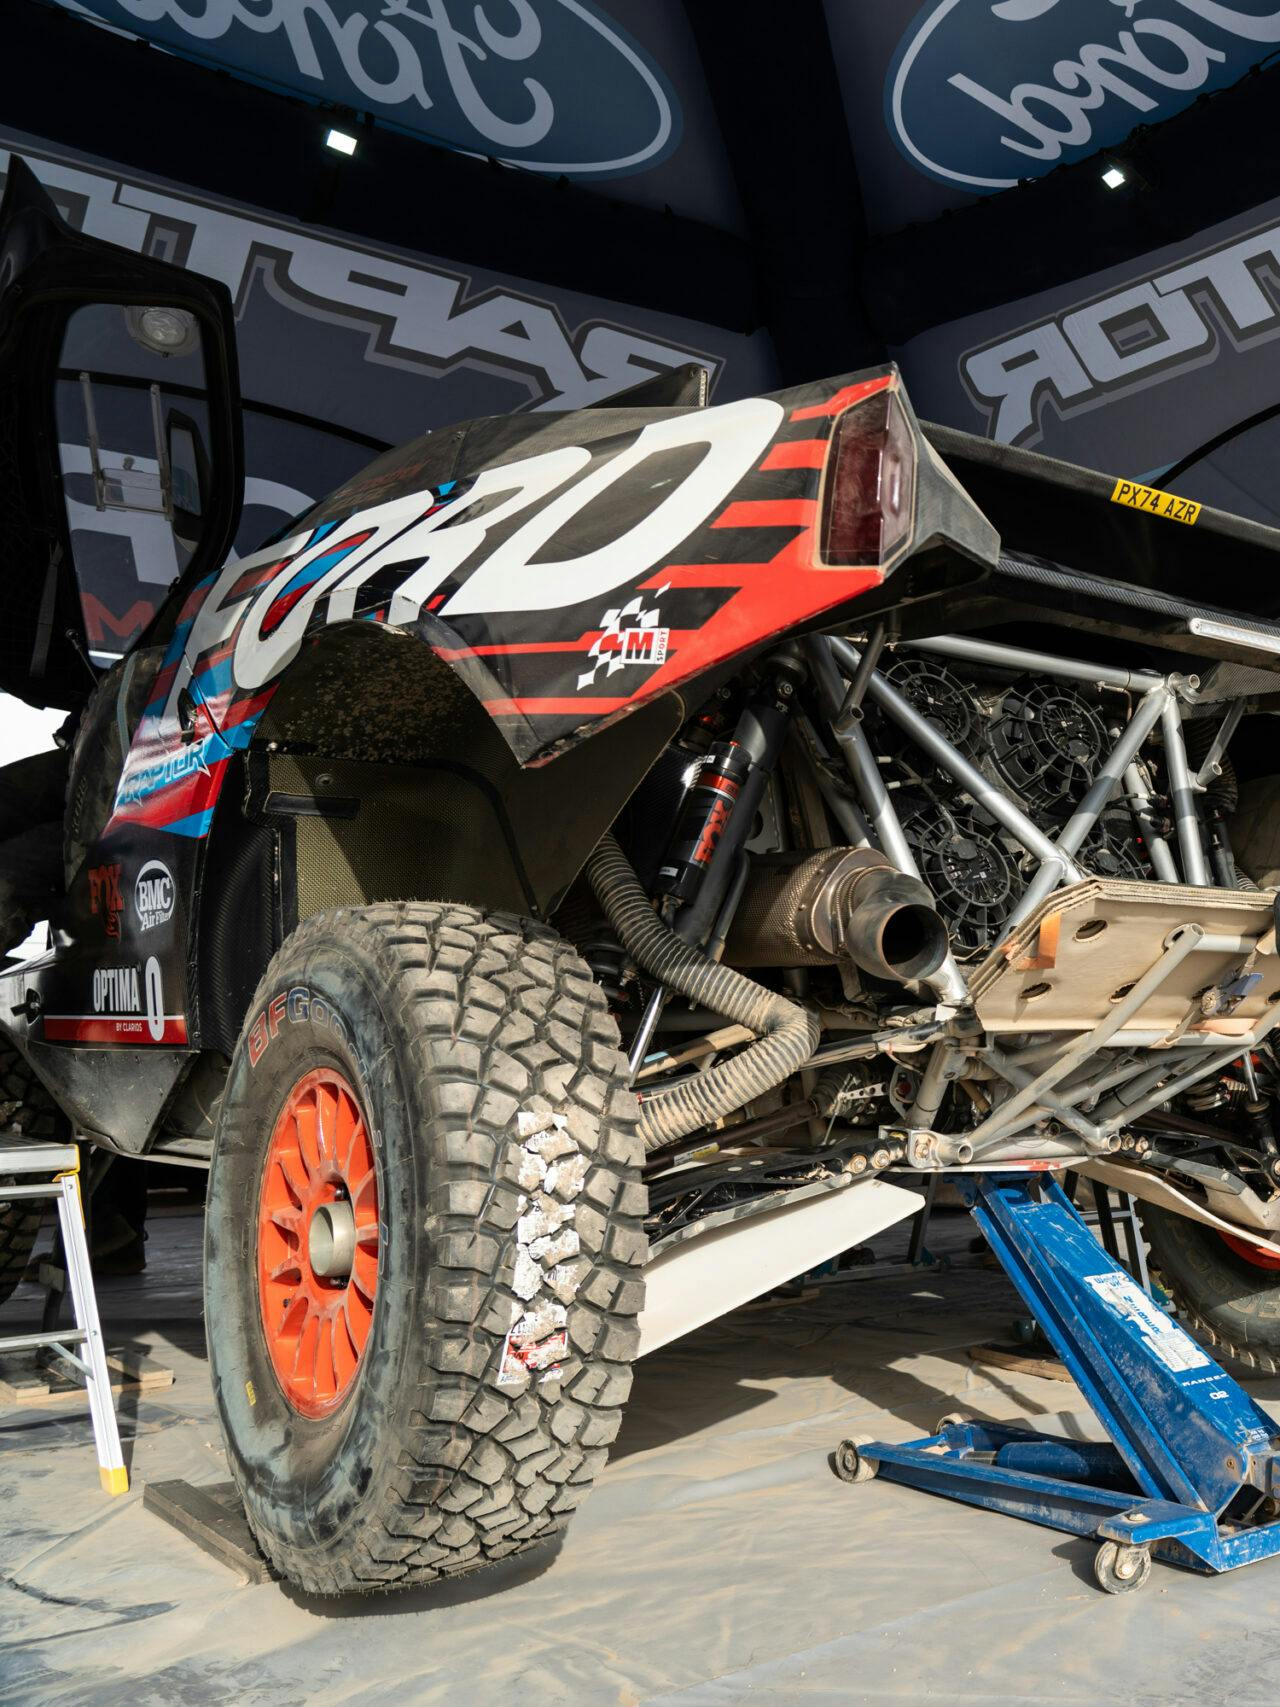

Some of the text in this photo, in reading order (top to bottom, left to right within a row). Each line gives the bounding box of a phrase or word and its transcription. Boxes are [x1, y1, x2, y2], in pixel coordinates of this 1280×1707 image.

[1117, 483, 1197, 522] PX74 AZR
[160, 398, 784, 725] FORD
[625, 631, 667, 662] M SPORT
[138, 877, 171, 912] BMC
[140, 912, 156, 932] Air
[93, 967, 141, 1012] OPTIMA
[115, 1022, 143, 1032] BY CLARIOS
